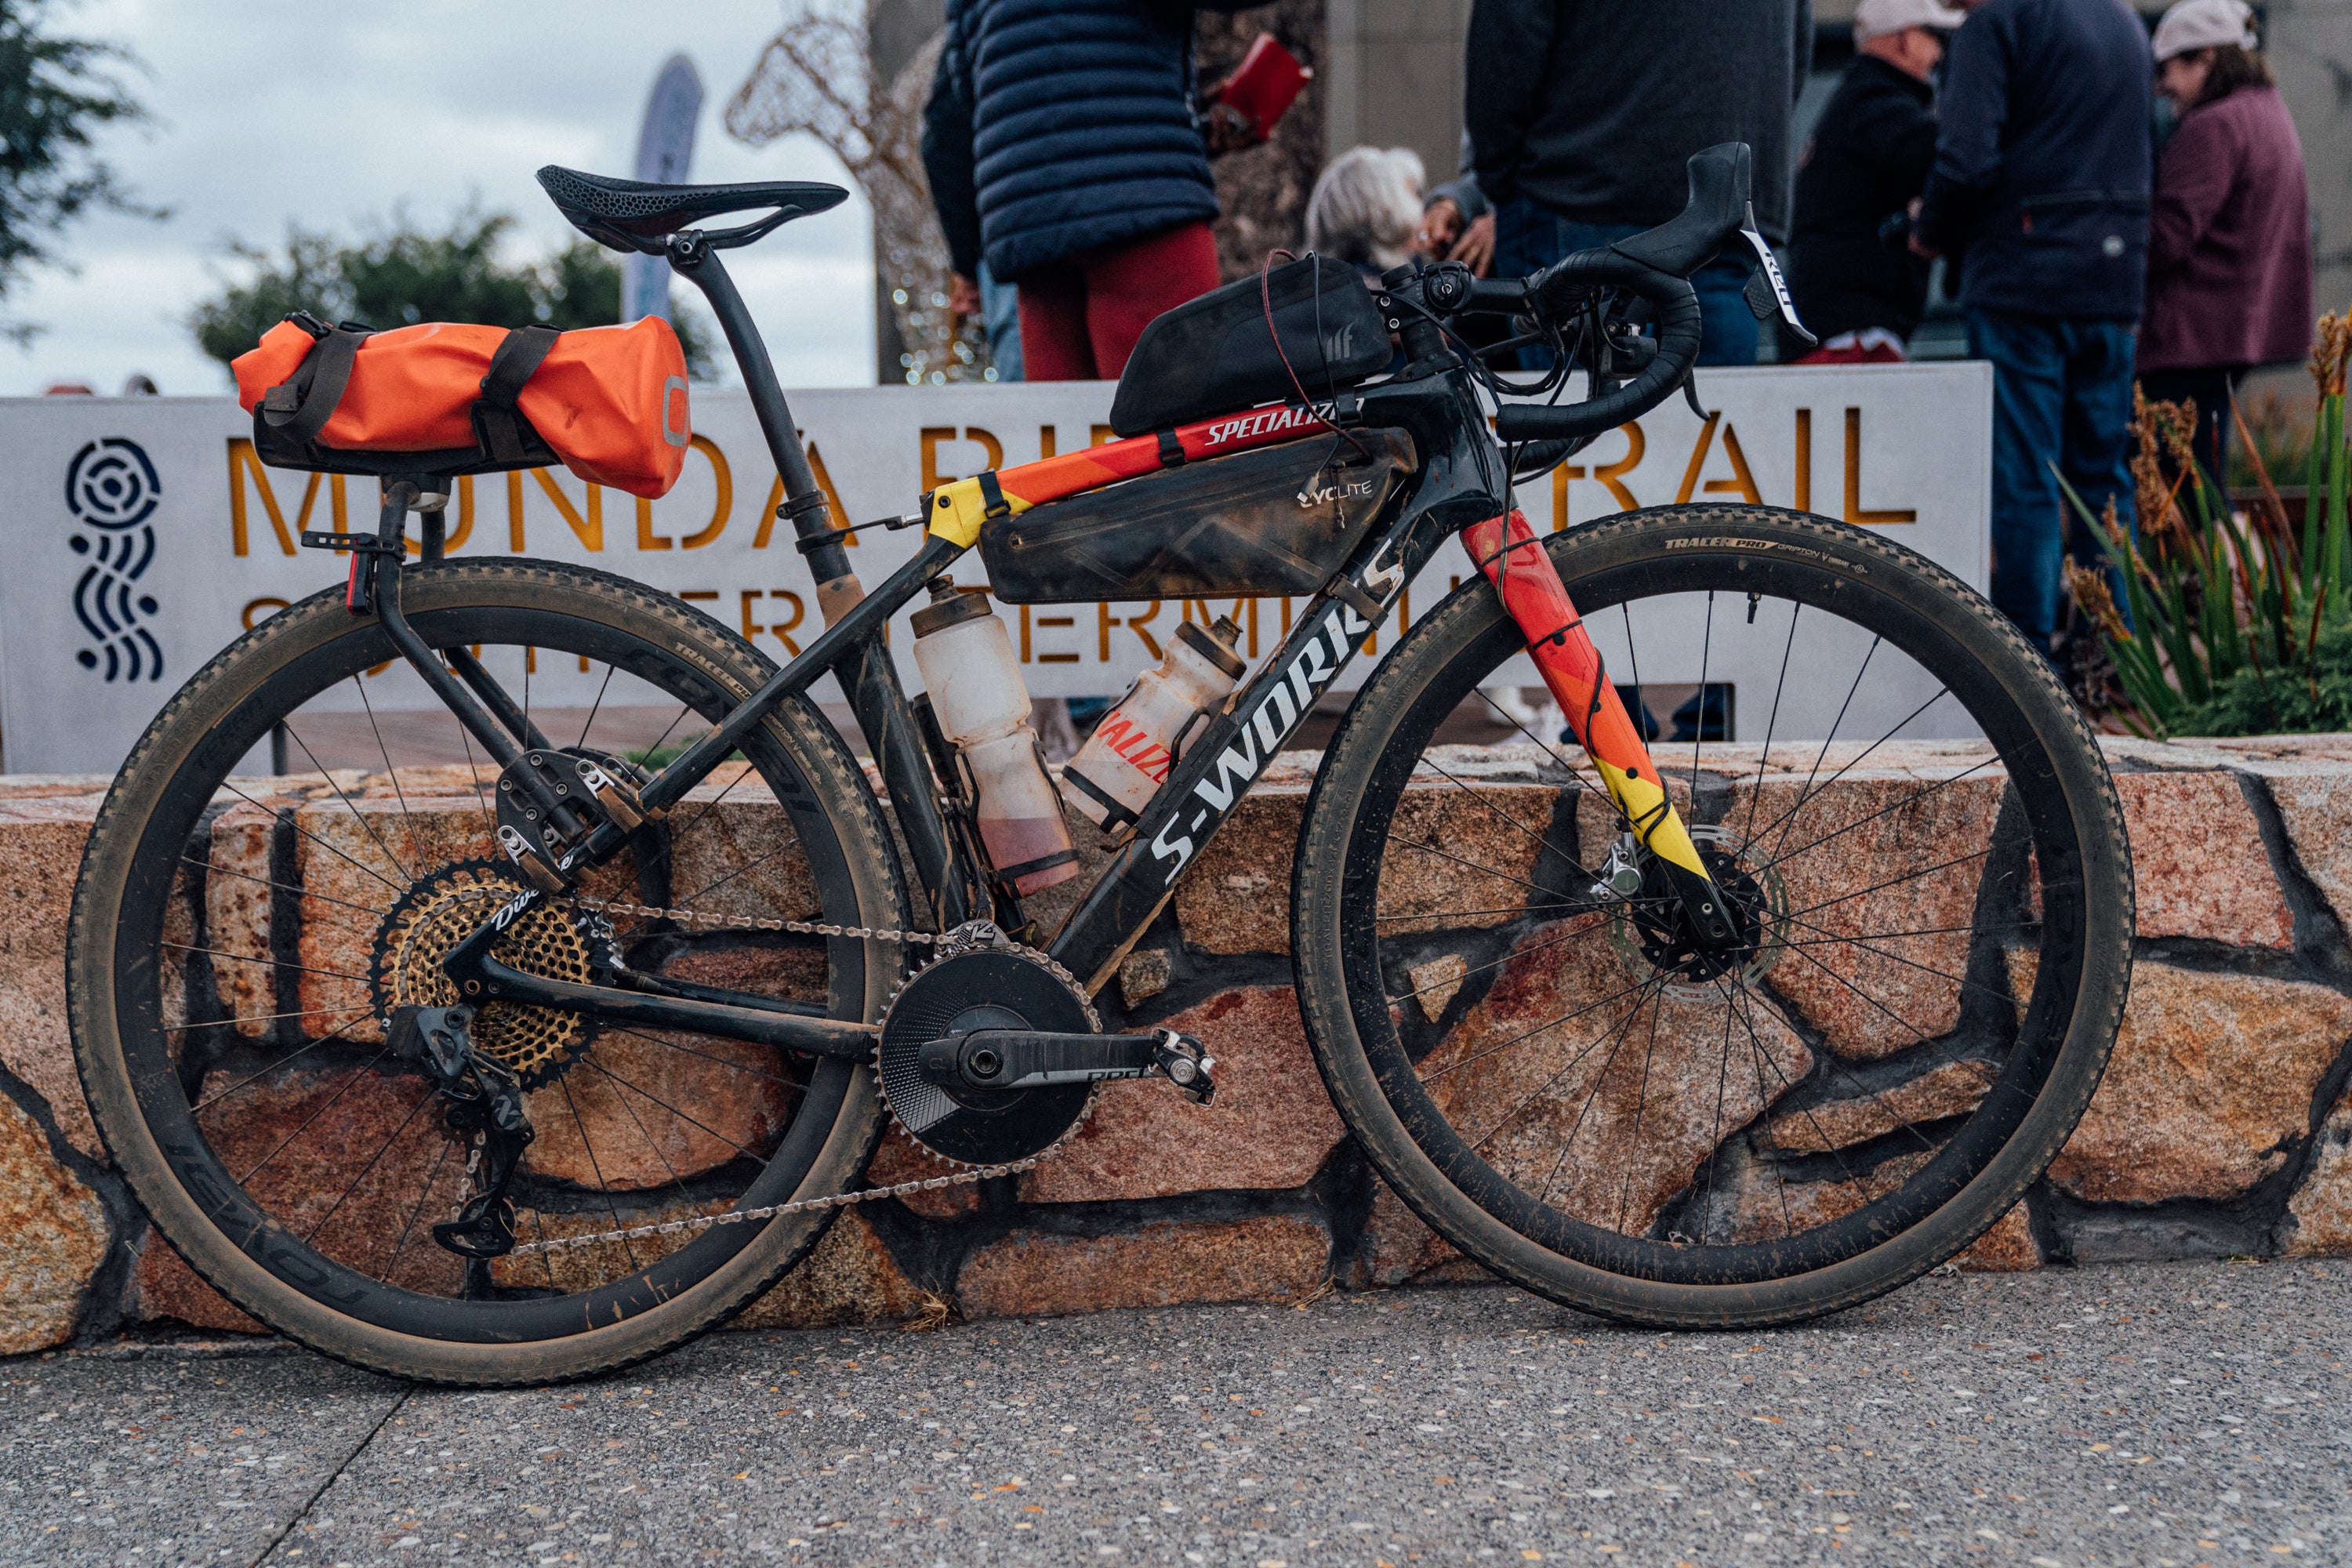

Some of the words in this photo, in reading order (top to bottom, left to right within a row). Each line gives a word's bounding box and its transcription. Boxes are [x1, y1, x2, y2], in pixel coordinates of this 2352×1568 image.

[1205, 397, 1365, 446] SPECIALIZ
[1487, 408, 1918, 530] RAIL
[1665, 537, 1730, 550] TRACER
[1735, 539, 1767, 549] PRO
[674, 641, 731, 684] TRACER
[733, 683, 753, 700] PR
[1150, 538, 1406, 886] S-WORKS
